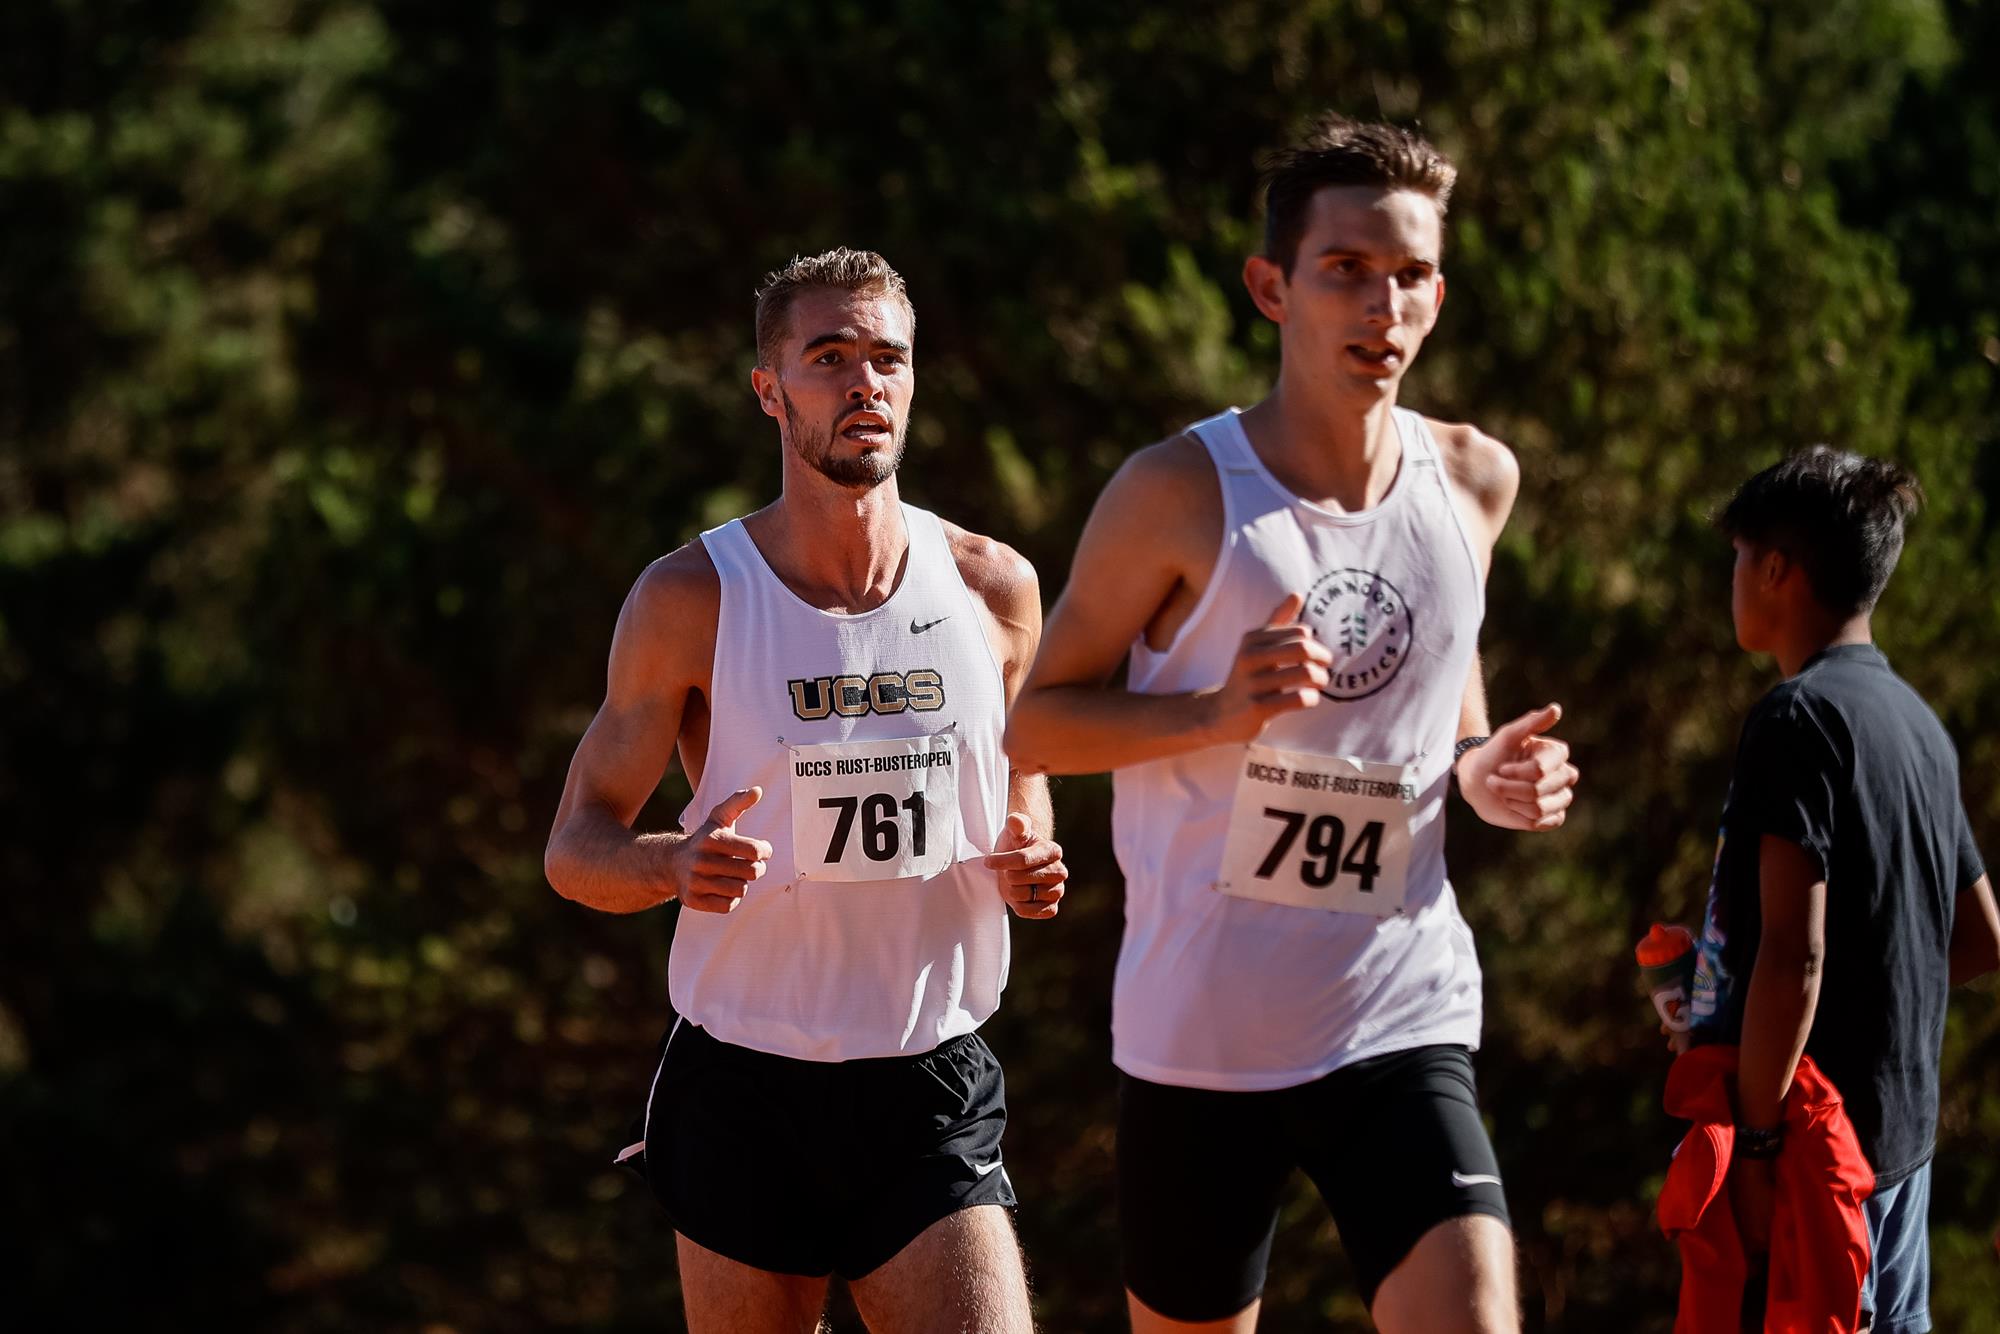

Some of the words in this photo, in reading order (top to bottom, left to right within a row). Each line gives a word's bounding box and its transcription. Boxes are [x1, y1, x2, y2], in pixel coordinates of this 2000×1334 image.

[1327, 646, 1397, 689] LETICS
[787, 669, 945, 721] UCCS
[795, 760, 832, 777] UCCS
[1247, 762, 1288, 785] UCCS
[818, 791, 926, 863] 761
[1254, 807, 1386, 893] 794
